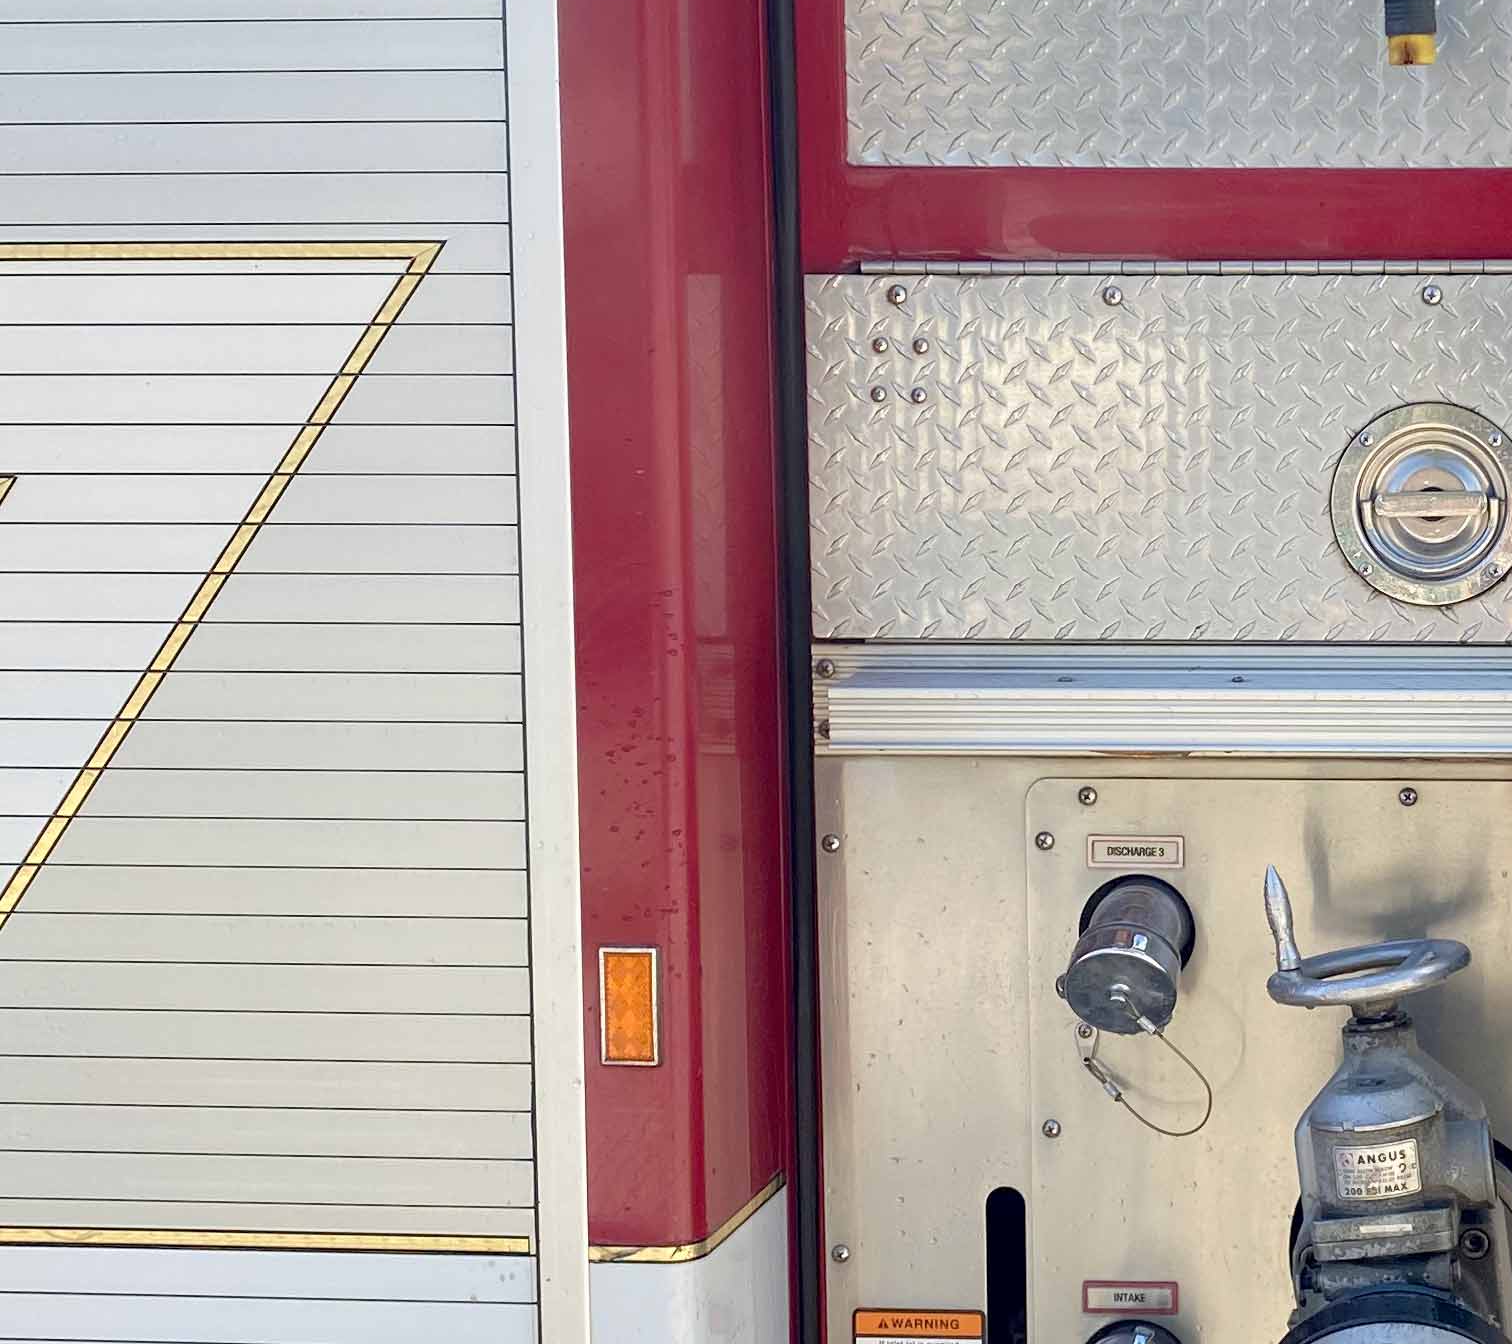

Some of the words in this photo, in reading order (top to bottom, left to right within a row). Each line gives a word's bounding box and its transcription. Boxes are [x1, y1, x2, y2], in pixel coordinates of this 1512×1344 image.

[1107, 846, 1157, 856] DISCHARGE
[1158, 848, 1165, 857] 3
[1357, 1150, 1406, 1165] ANGUS
[1345, 1187, 1362, 1196] 200
[1385, 1182, 1408, 1193] MAX
[1113, 1293, 1145, 1303] INTAKE
[891, 1318, 960, 1330] WARNING
